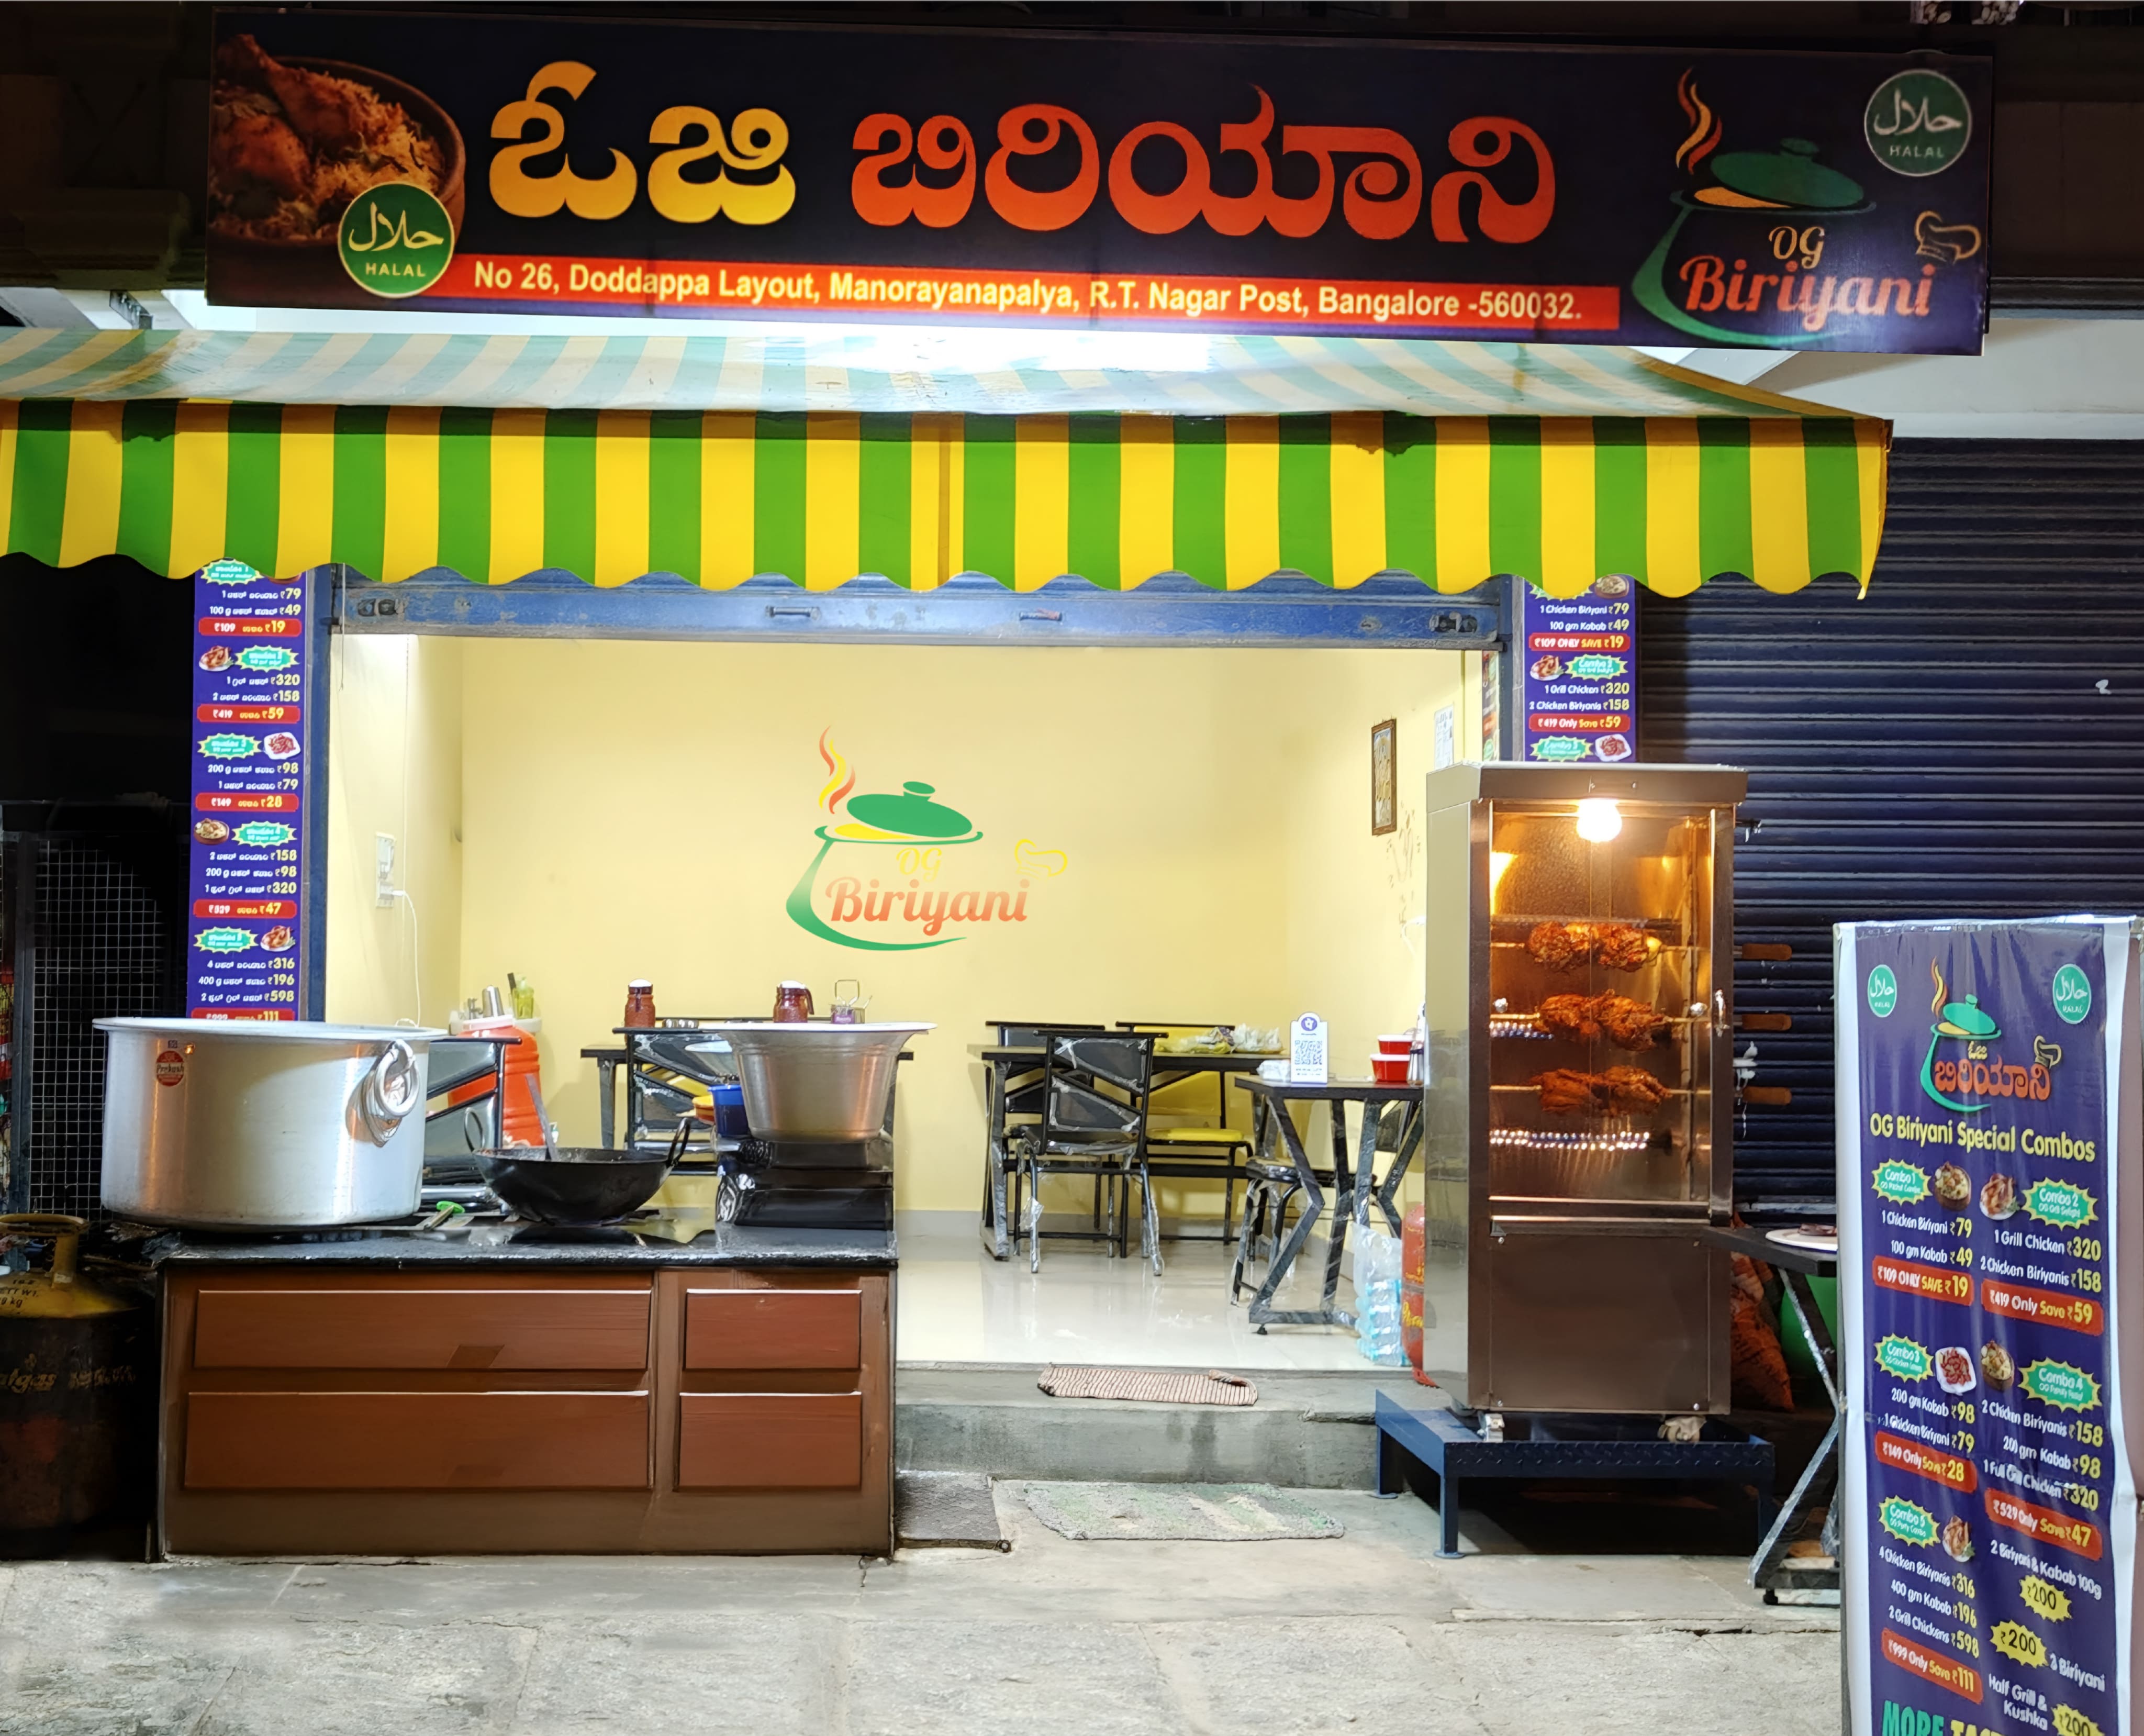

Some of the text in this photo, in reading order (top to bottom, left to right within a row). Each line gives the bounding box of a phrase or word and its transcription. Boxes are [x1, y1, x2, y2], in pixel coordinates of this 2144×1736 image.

[1873, 88, 1963, 136] حلال
[489, 59, 1556, 243] ಓಜಿ ಬಿರಿಯಾನಿ
[1889, 145, 1945, 159] HALAL
[349, 202, 444, 251] حلال
[1769, 226, 1825, 269] OG
[366, 262, 426, 277] HALAL
[474, 261, 1581, 324] No 26, Doddappa Layout, Manorayanapalya, R.T. Nagar Post, Bangalore -560032.
[1679, 255, 1936, 331] Biriyani
[210, 606, 224, 615] 100
[1550, 621, 1564, 630] 100
[271, 674, 300, 686] ₹320
[273, 691, 300, 702] ₹158
[262, 707, 284, 719] ₹59
[208, 764, 224, 773] 200
[277, 762, 298, 774] ₹98
[277, 778, 298, 789] ₹79
[206, 868, 221, 876] 200
[275, 866, 297, 877] ₹98
[896, 847, 942, 882] OG
[267, 882, 297, 894] ₹320
[825, 876, 1028, 936] Biriyani
[268, 958, 295, 969] ₹316
[268, 974, 294, 985] ₹196
[1935, 1053, 2051, 1101] ಬಿರಿಯಾನಿ
[1870, 1113, 2095, 1162] OG Biriyani Special Combos
[1885, 1169, 1911, 1184] Combo
[2039, 1188, 2079, 1207] Combo 2
[1882, 1210, 1972, 1238] 1 Chicken Biriyani ₹79
[1891, 1240, 1904, 1254] 100
[1906, 1245, 1919, 1259] gm
[1950, 1247, 1973, 1267] ₹49
[1995, 1229, 2101, 1261] 1 Grill Chicken ₹320
[1945, 1275, 1968, 1297] ₹19
[1980, 1255, 2102, 1293] 2 Chicken Biriyanis ₹158
[1990, 1289, 2009, 1307] ₹419
[2012, 1295, 2038, 1316] Only
[2068, 1301, 2093, 1325] ₹59
[2039, 1368, 2083, 1391] Combo 4
[1892, 1387, 1907, 1404] 200
[1909, 1395, 1921, 1409] gm
[1951, 1401, 1975, 1424] ₹98
[1982, 1399, 1988, 1414] 2
[2023, 1413, 2067, 1437] Biriyanis
[2069, 1420, 2103, 1448] ₹158
[1952, 1430, 1974, 1453] ₹79
[2003, 1435, 2101, 1478] 200 gm Kabab ₹98
[1903, 1449, 1922, 1470] Only
[1941, 1459, 1964, 1482] ₹28
[1984, 1459, 1988, 1473] 1
[2023, 1474, 2061, 1498] Chicken
[2063, 1483, 2098, 1511] ₹320
[1890, 1504, 1919, 1524] Combo
[2065, 1524, 2091, 1548] ₹47
[1991, 1540, 1998, 1554] 2
[2040, 1561, 2076, 1586] Kabab
[2078, 1574, 2102, 1600] 100g
[1952, 1573, 1975, 1599] ₹316
[2027, 1583, 2056, 1610] ₹200
[1891, 1579, 1906, 1596] 400
[1908, 1589, 1922, 1603] gm
[1952, 1601, 1976, 1628] ₹196
[1889, 1605, 1894, 1619] 2
[1951, 1630, 1979, 1658] ₹598
[2001, 1629, 2036, 1655] ₹200
[1908, 1651, 1928, 1672] Only
[1952, 1666, 1973, 1692] ₹111
[2059, 1657, 2105, 1692] Biriyani
[1989, 1673, 2047, 1711] Half Grill &
[1882, 1700, 1944, 1736] MORE
[2004, 1700, 2048, 1730] Kushka
